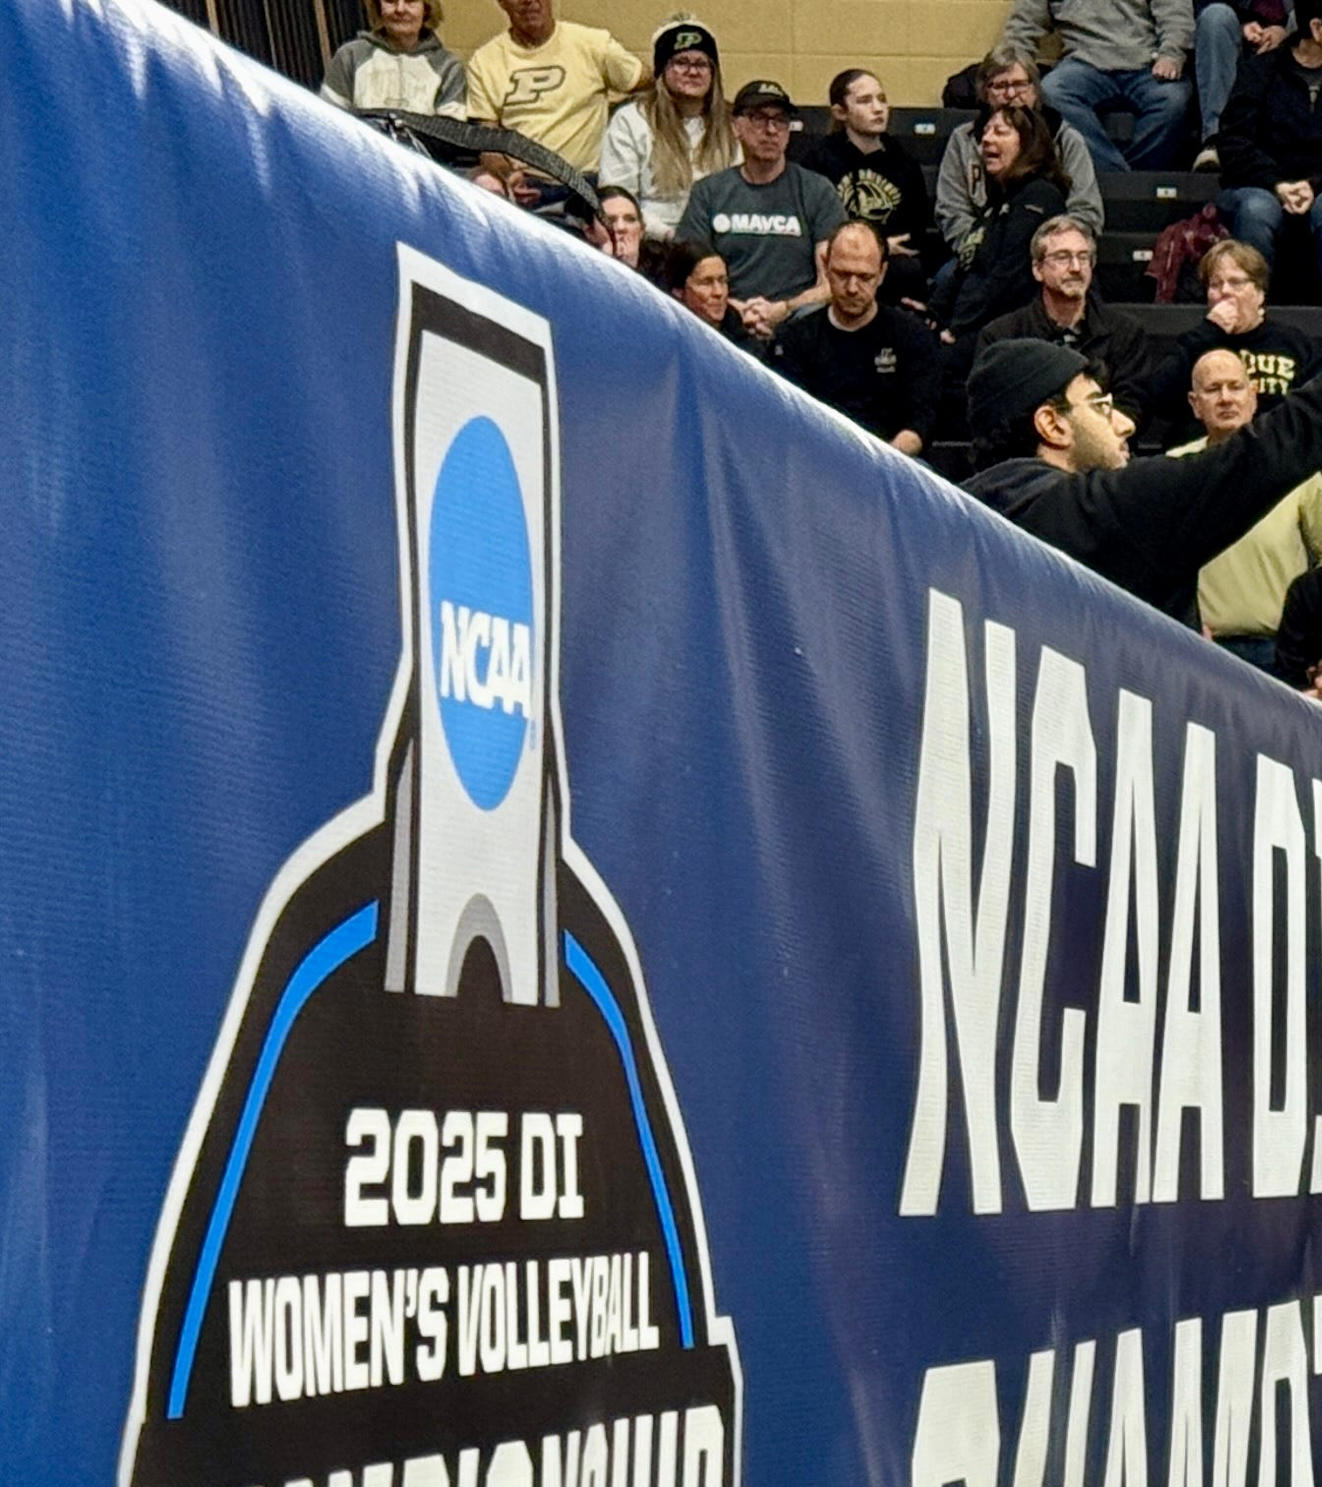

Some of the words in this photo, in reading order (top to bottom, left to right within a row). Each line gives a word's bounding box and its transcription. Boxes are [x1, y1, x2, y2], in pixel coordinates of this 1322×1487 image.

[503, 65, 566, 107] P
[440, 600, 531, 720] NCAA
[899, 590, 1225, 1217] NCAA
[344, 1108, 507, 1228] 2025
[520, 1112, 584, 1221] DI
[228, 1264, 449, 1408] WOMEN'S
[458, 1252, 660, 1377] VOLLEYBALL
